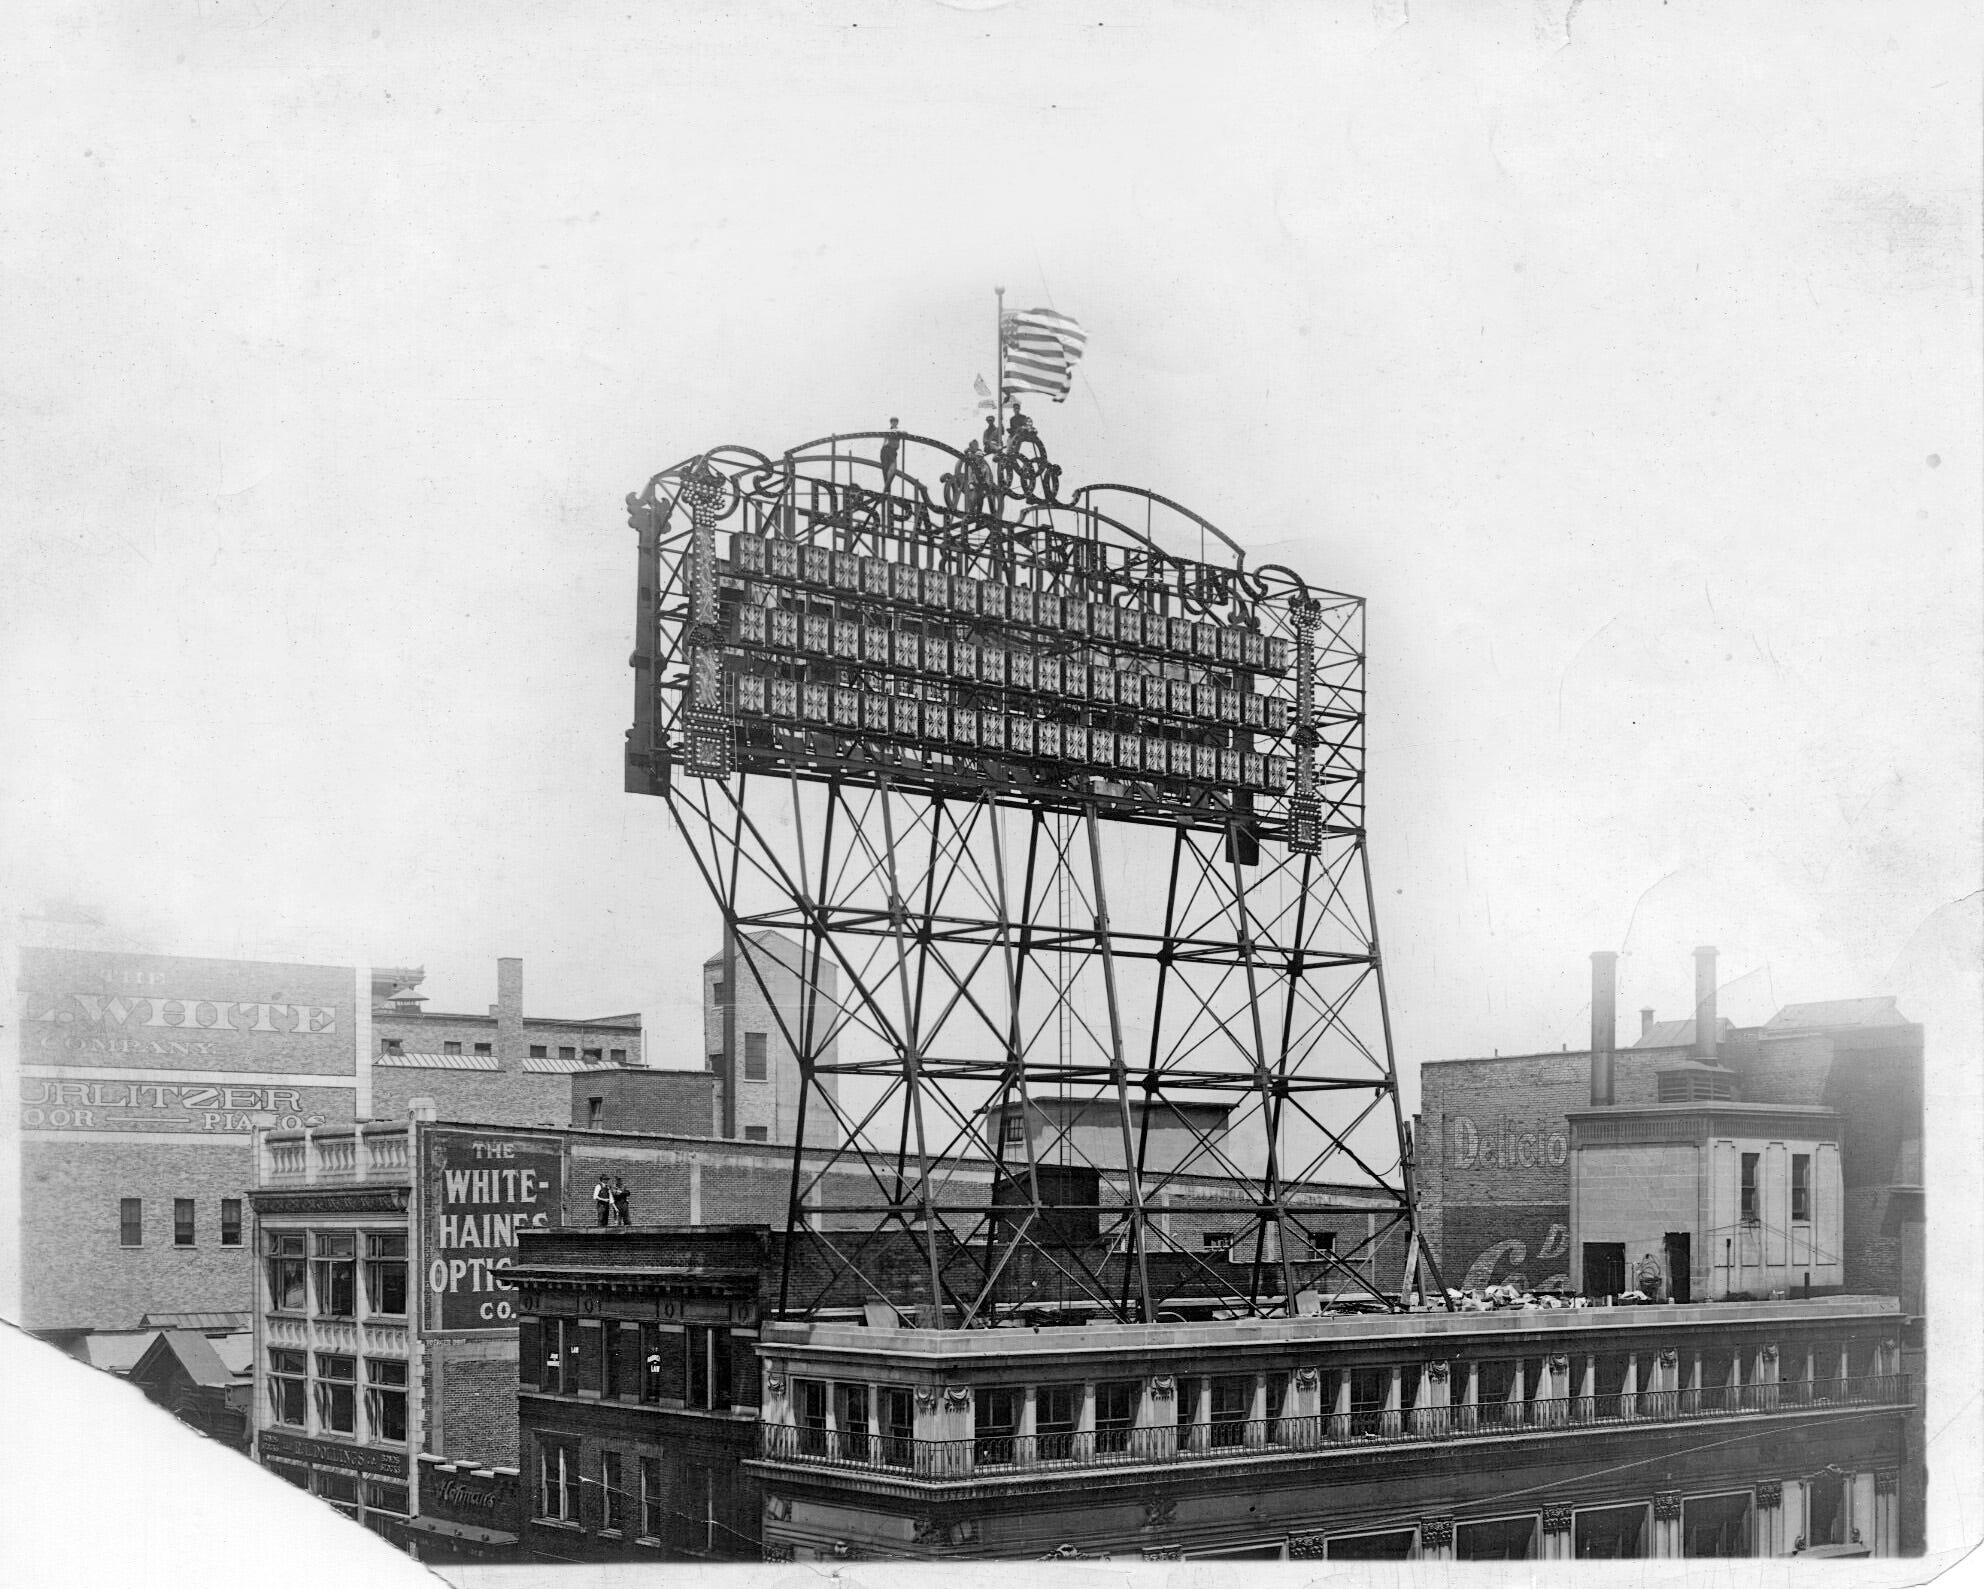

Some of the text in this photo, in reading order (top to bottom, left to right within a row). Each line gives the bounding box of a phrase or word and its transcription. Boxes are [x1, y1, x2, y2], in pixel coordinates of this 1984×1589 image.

[67, 993, 337, 1035] WHITE
[472, 1143, 515, 1159] THE
[444, 1168, 549, 1203] WHITE-
[479, 1301, 517, 1320] CO.
